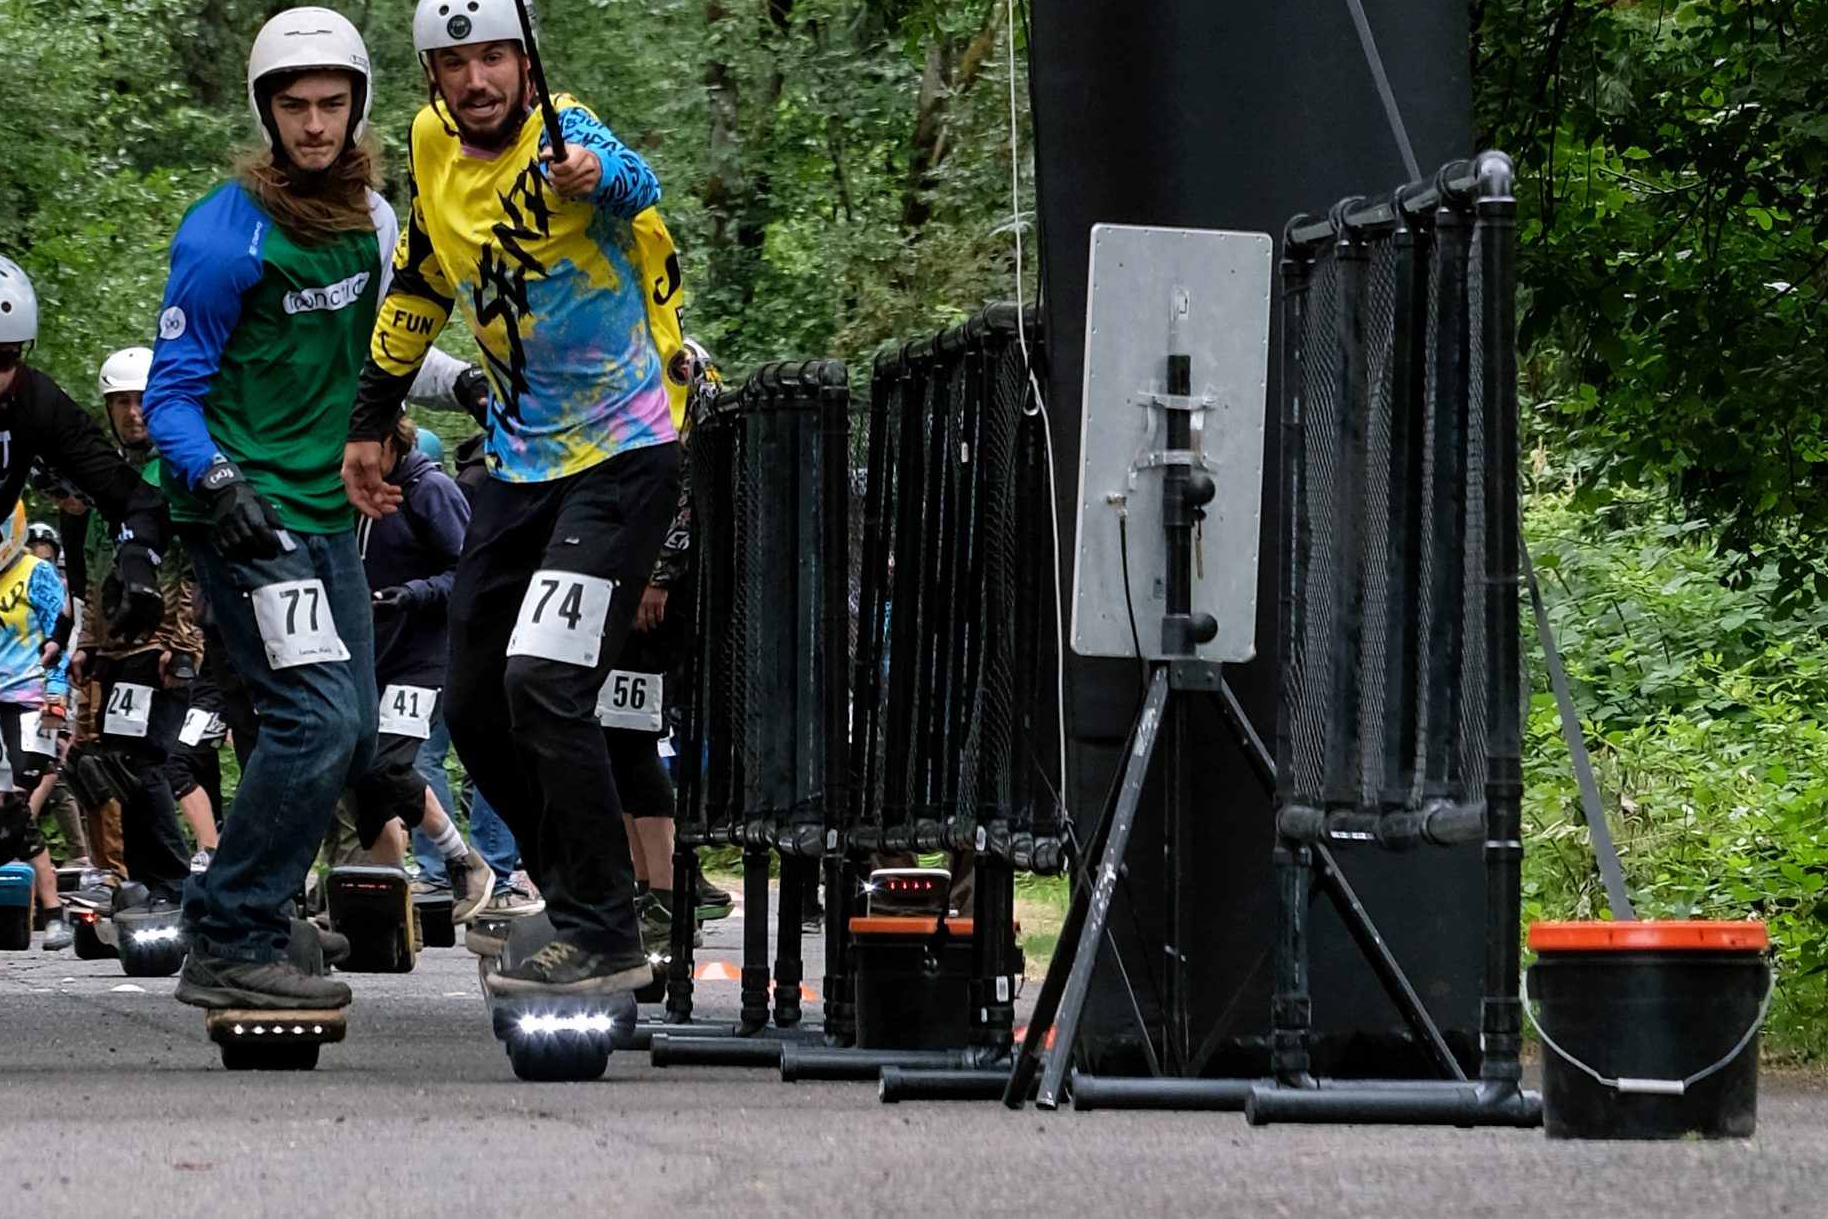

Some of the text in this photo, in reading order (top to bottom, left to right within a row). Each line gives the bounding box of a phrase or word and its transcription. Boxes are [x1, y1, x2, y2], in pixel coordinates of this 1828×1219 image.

[392, 309, 435, 335] FUN
[279, 587, 319, 636] 77
[531, 579, 584, 630] 74
[106, 687, 134, 716] 24
[392, 689, 420, 718] 41
[612, 675, 647, 710] 56
